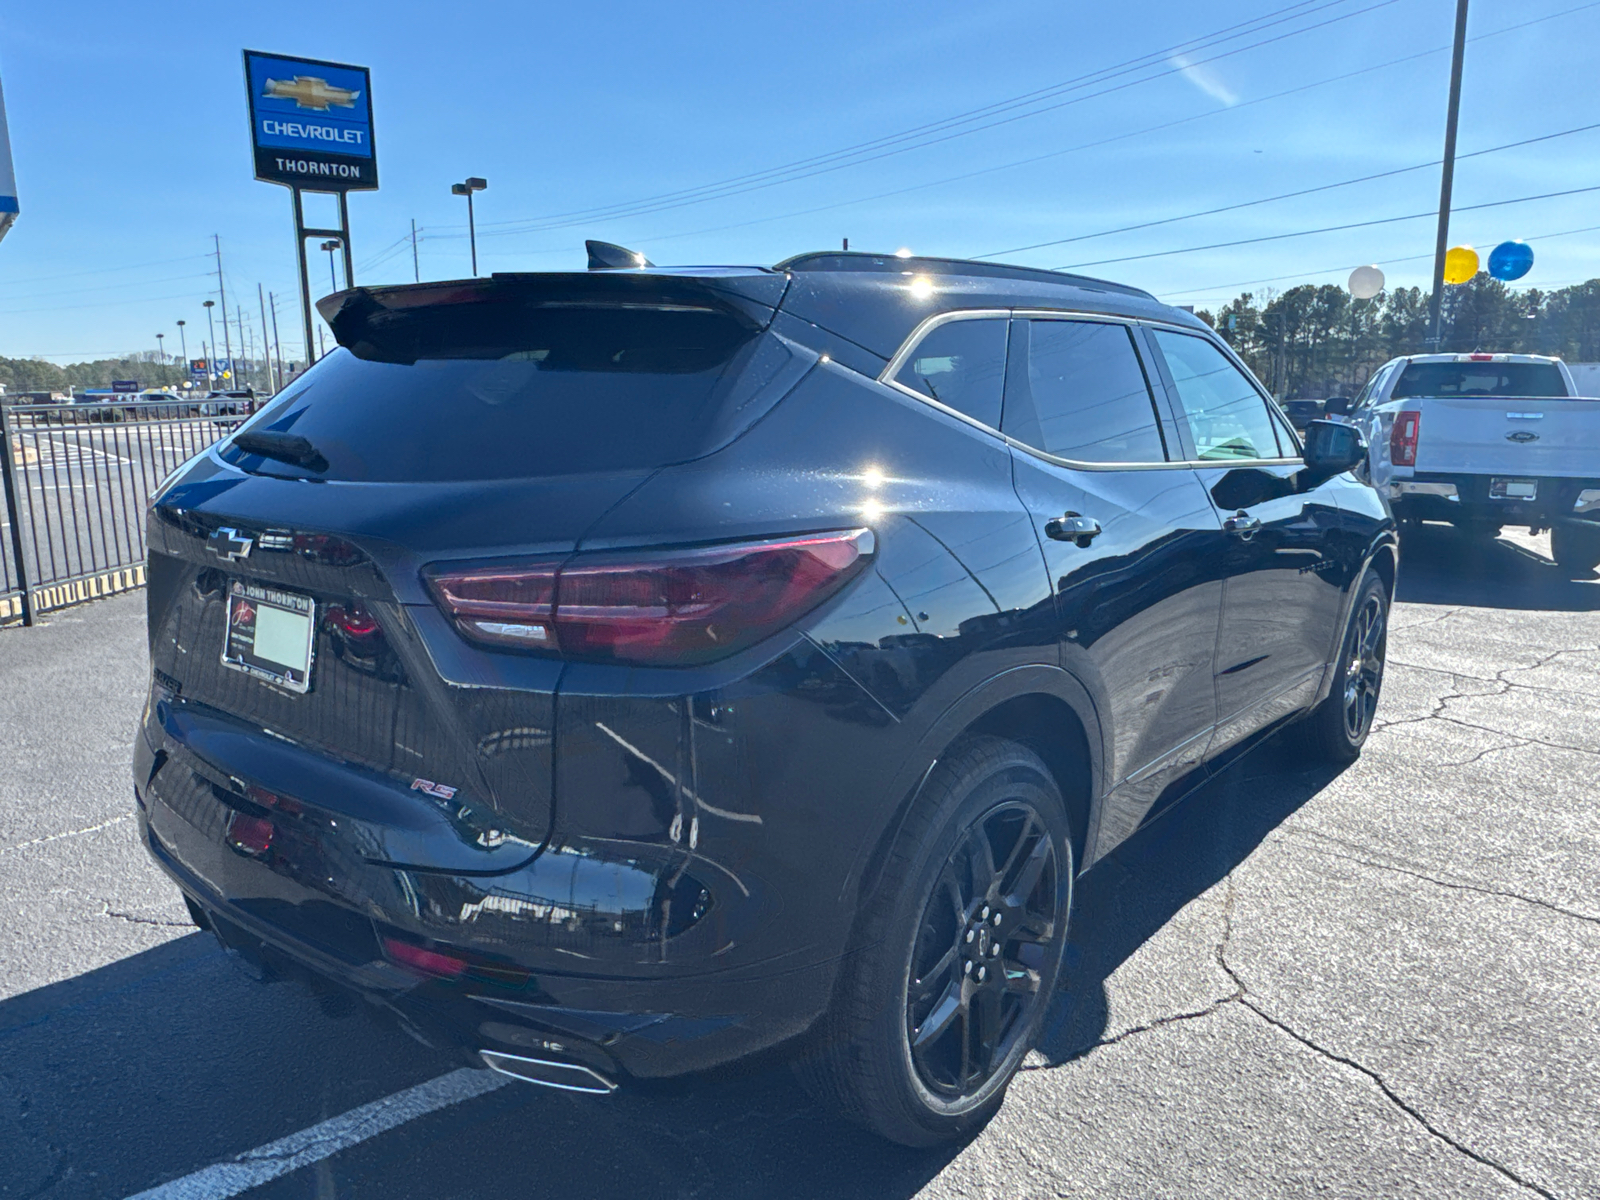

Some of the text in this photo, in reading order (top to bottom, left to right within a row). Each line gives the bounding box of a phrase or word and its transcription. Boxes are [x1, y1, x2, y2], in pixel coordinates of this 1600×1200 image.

[262, 120, 364, 144] CHEVROLET
[275, 158, 360, 178] THORNTON
[246, 585, 266, 599] JOHN
[410, 778, 458, 799] RS
